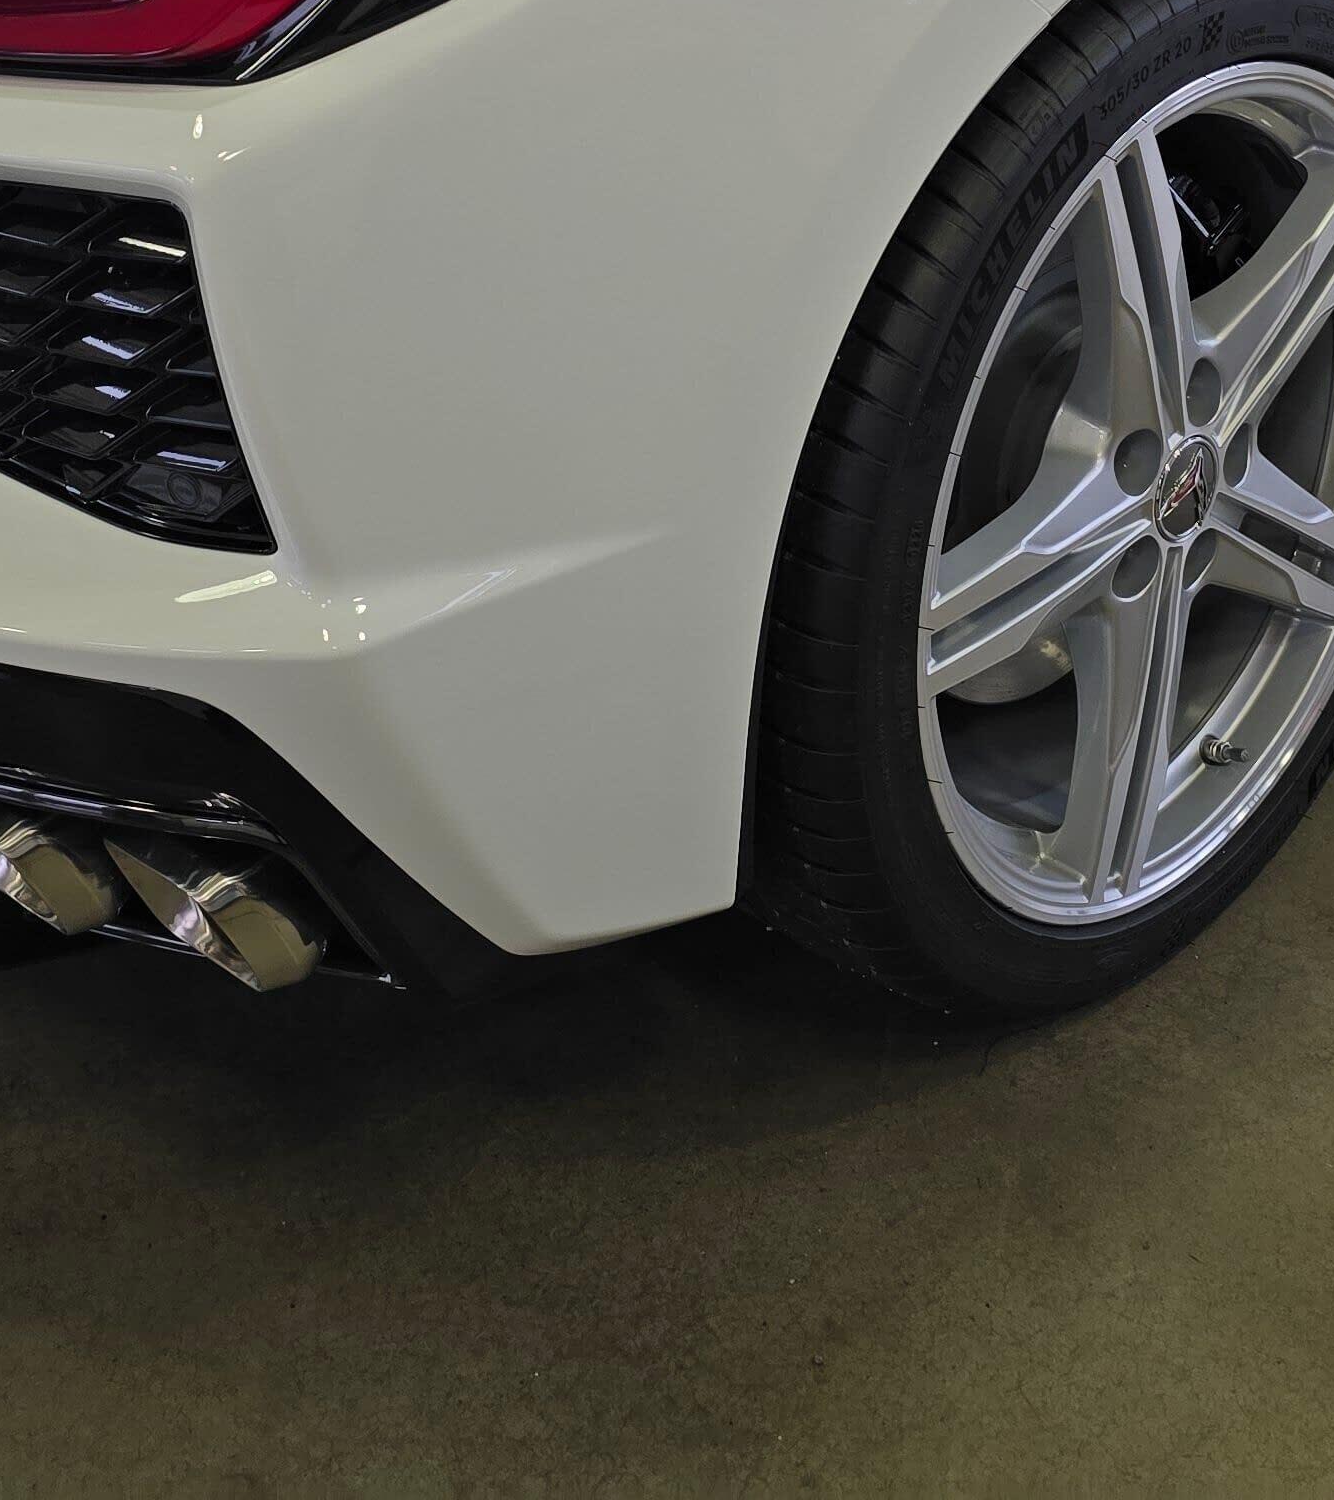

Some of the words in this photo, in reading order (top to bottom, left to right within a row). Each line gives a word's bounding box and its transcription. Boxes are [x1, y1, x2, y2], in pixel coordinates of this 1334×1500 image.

[1099, 65, 1149, 120] 305/30
[1153, 49, 1171, 74] ZR
[1175, 36, 1192, 60] 20
[937, 122, 1084, 392] MICHELIN
